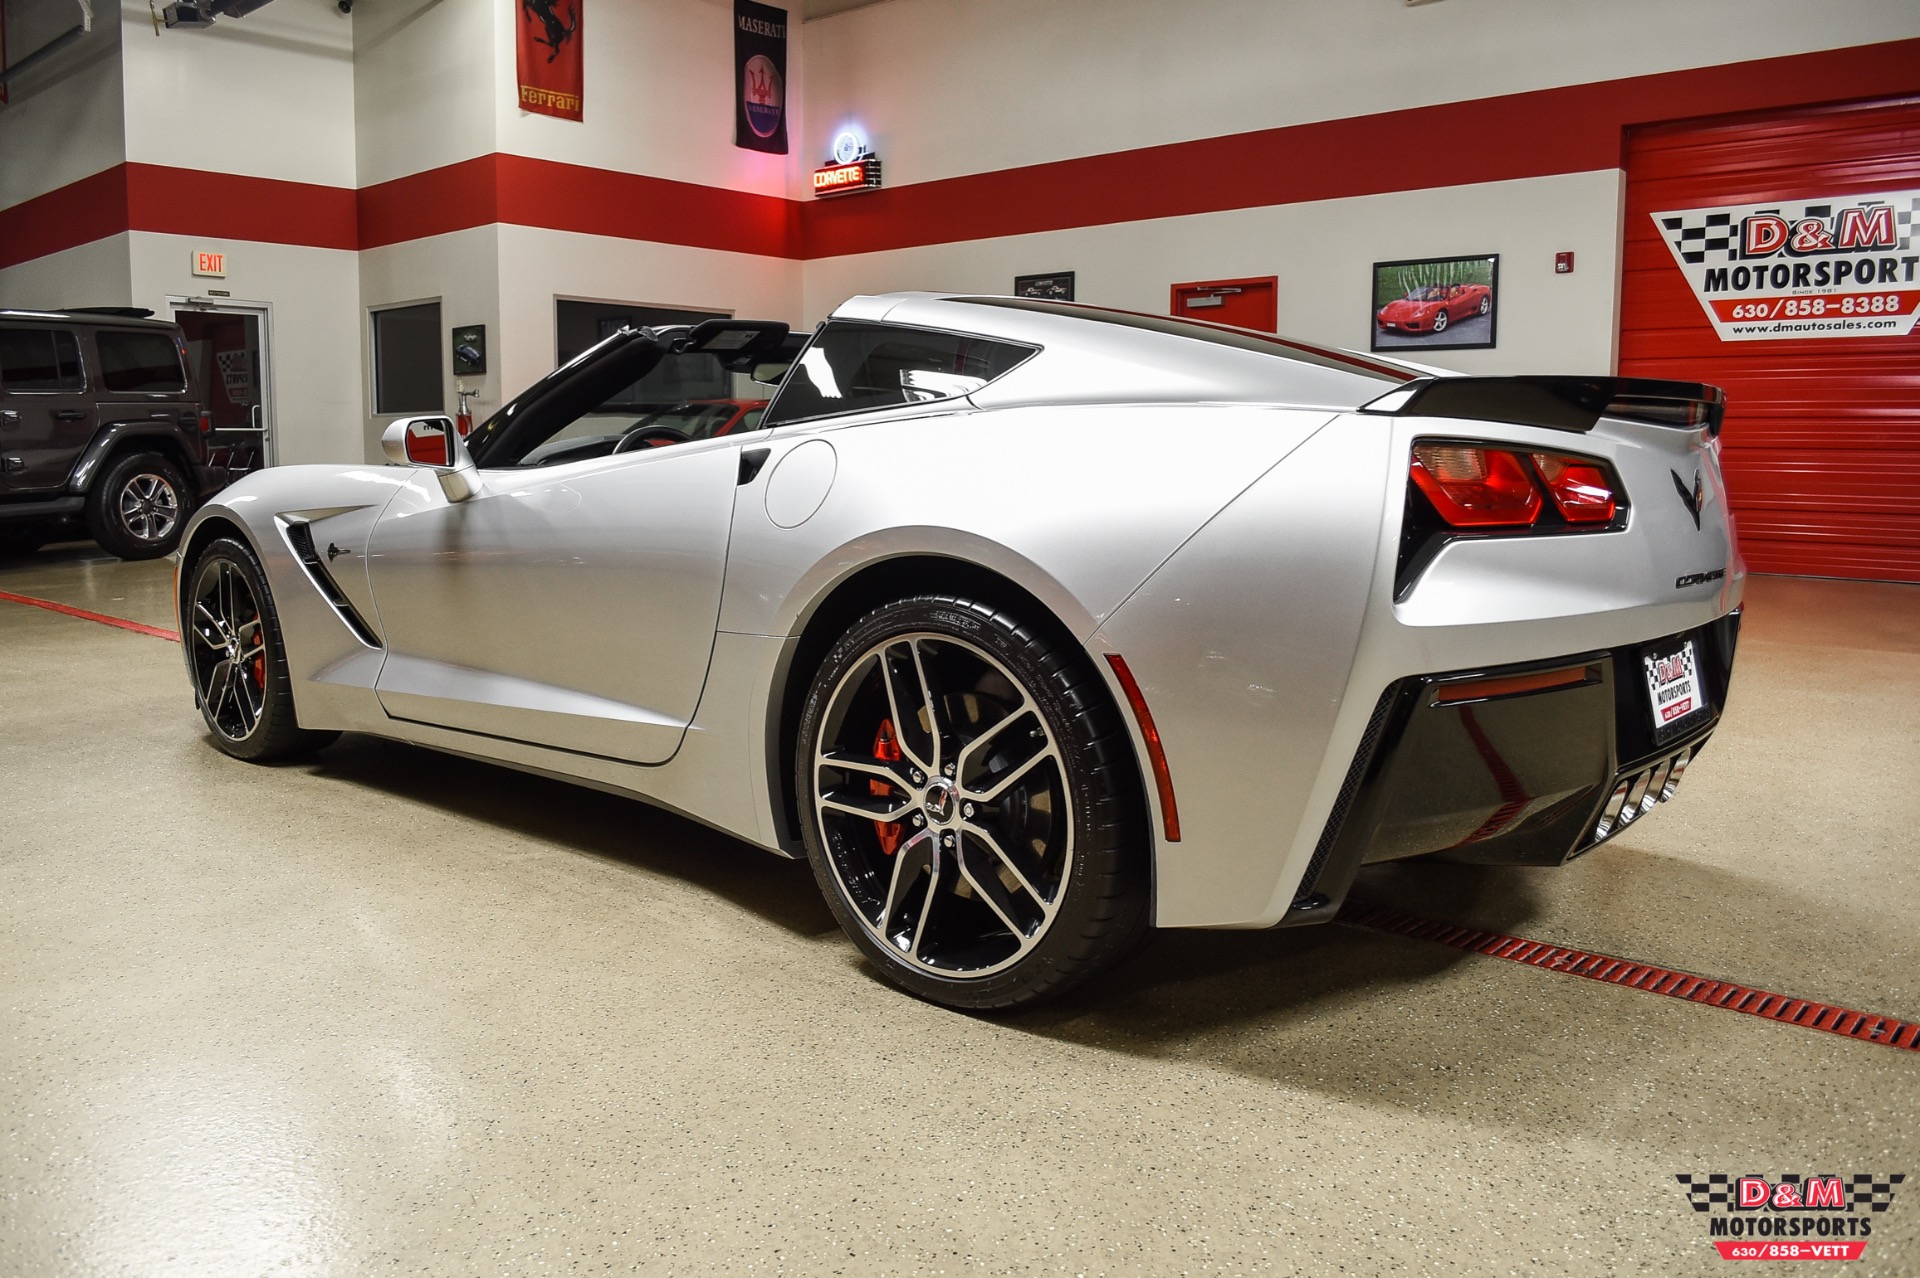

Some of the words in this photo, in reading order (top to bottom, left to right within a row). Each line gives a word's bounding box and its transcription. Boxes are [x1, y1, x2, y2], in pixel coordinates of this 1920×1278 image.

[738, 15, 786, 38] MASERATI
[520, 84, 579, 112] Ferrari
[814, 166, 863, 187] CORVETTE
[1740, 204, 1898, 261] D&M
[199, 253, 223, 273] EXIT
[1732, 320, 1897, 333] www.dmautosales.com
[1657, 680, 1691, 705] MOTORSPORTS
